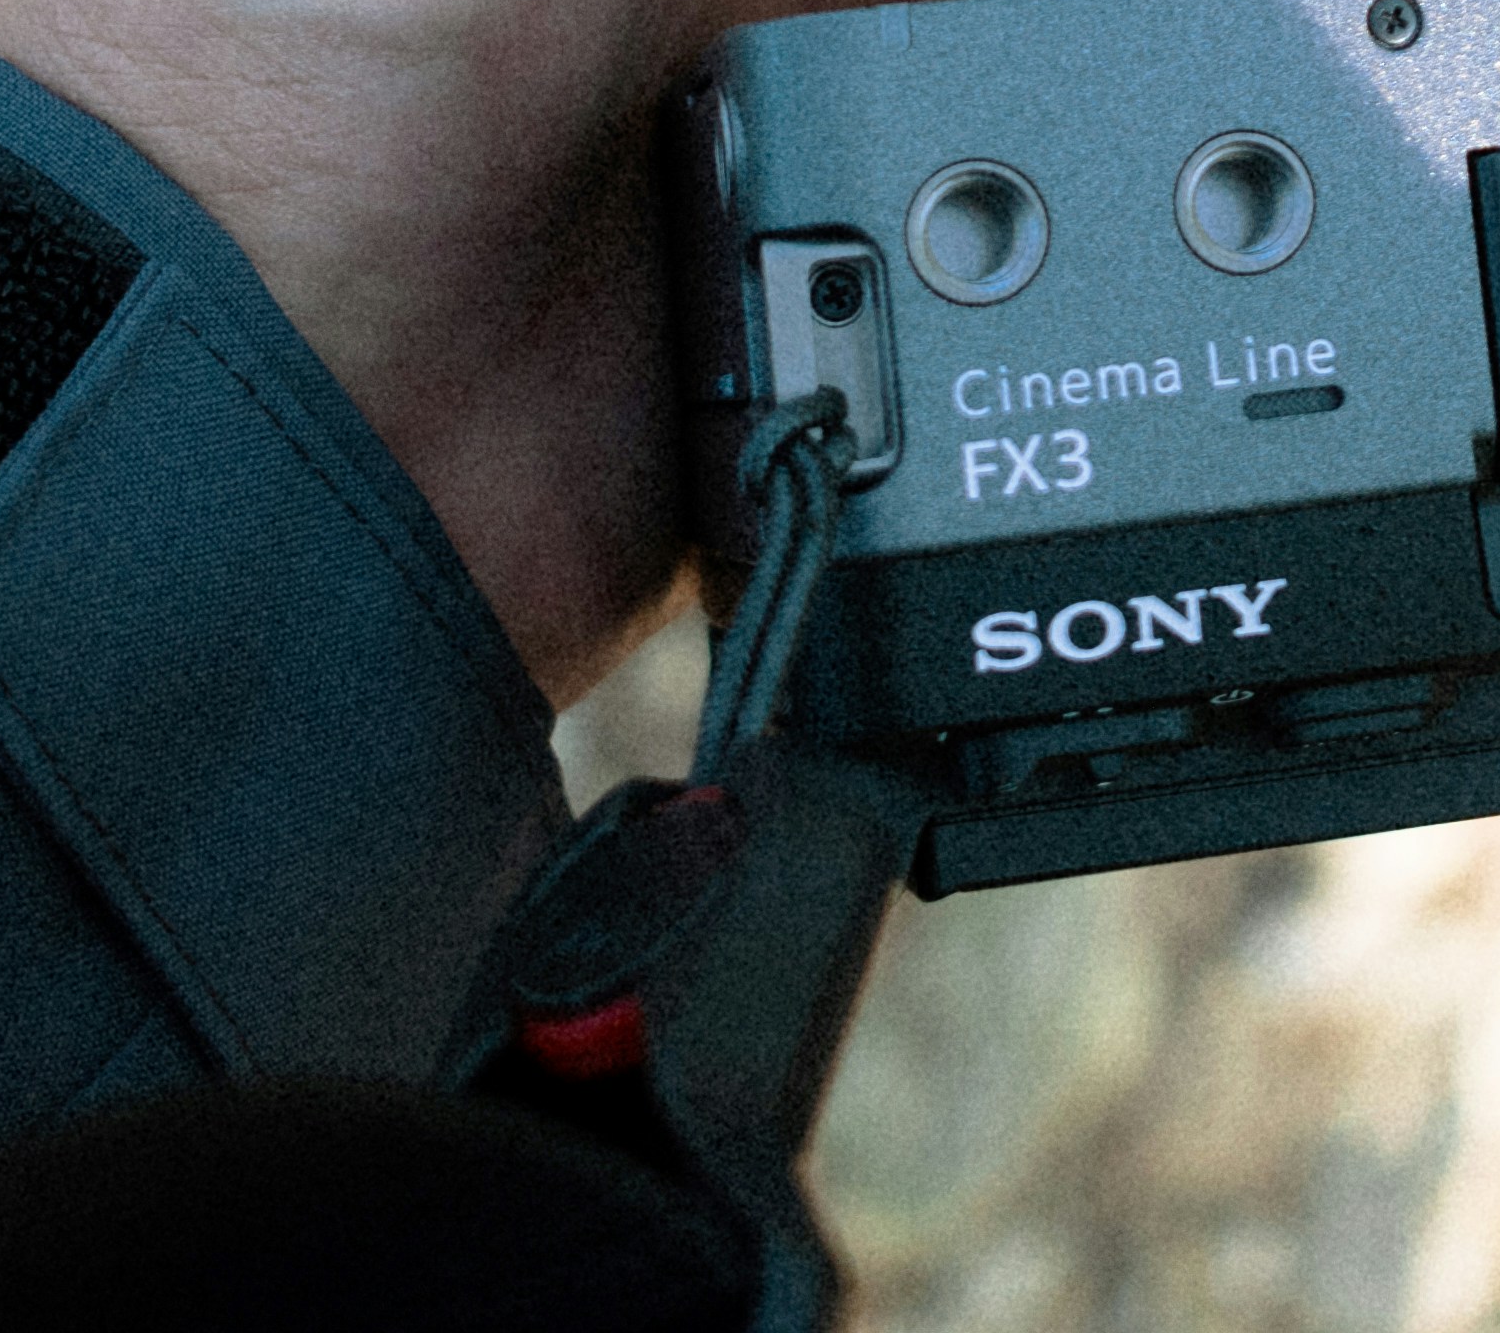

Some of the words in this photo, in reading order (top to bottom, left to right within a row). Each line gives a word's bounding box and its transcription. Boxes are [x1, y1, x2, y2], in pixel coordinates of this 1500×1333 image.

[952, 356, 1182, 418] Cinema
[1207, 335, 1337, 390] Line
[961, 428, 1094, 500] FX3
[971, 578, 1288, 673] SONY
